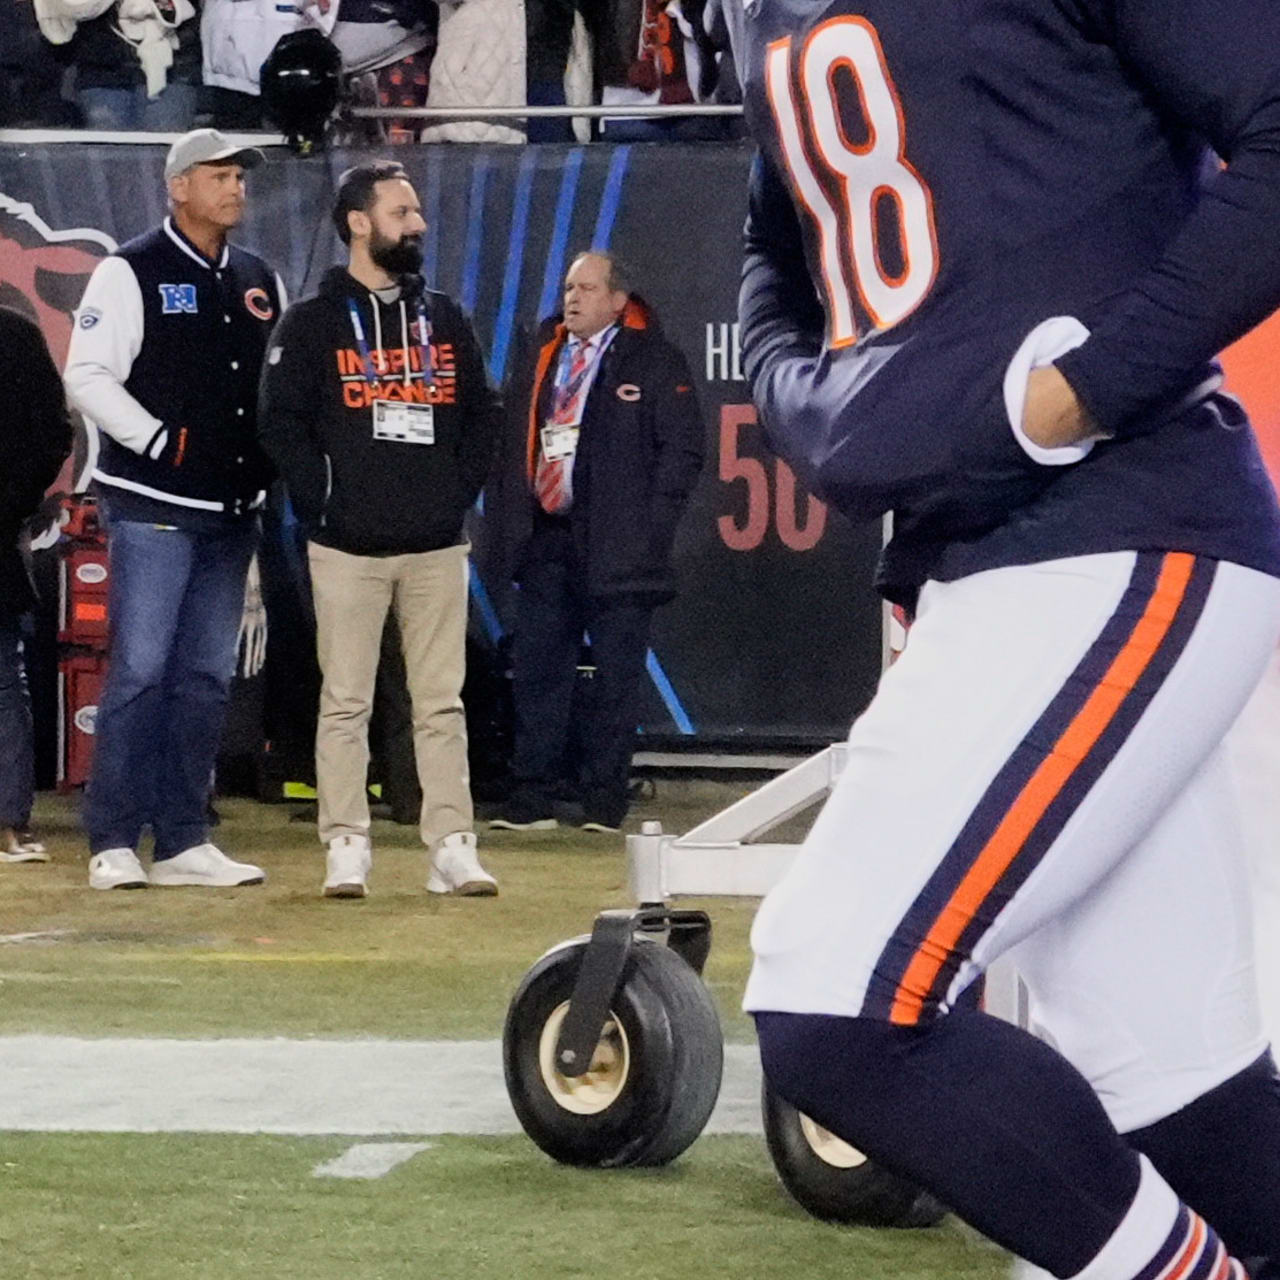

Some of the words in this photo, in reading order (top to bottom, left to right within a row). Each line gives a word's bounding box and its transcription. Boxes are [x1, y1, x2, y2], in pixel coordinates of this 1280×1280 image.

[766, 13, 940, 350] 18
[336, 344, 456, 375] INSPIRE
[342, 378, 456, 408] CHANGE
